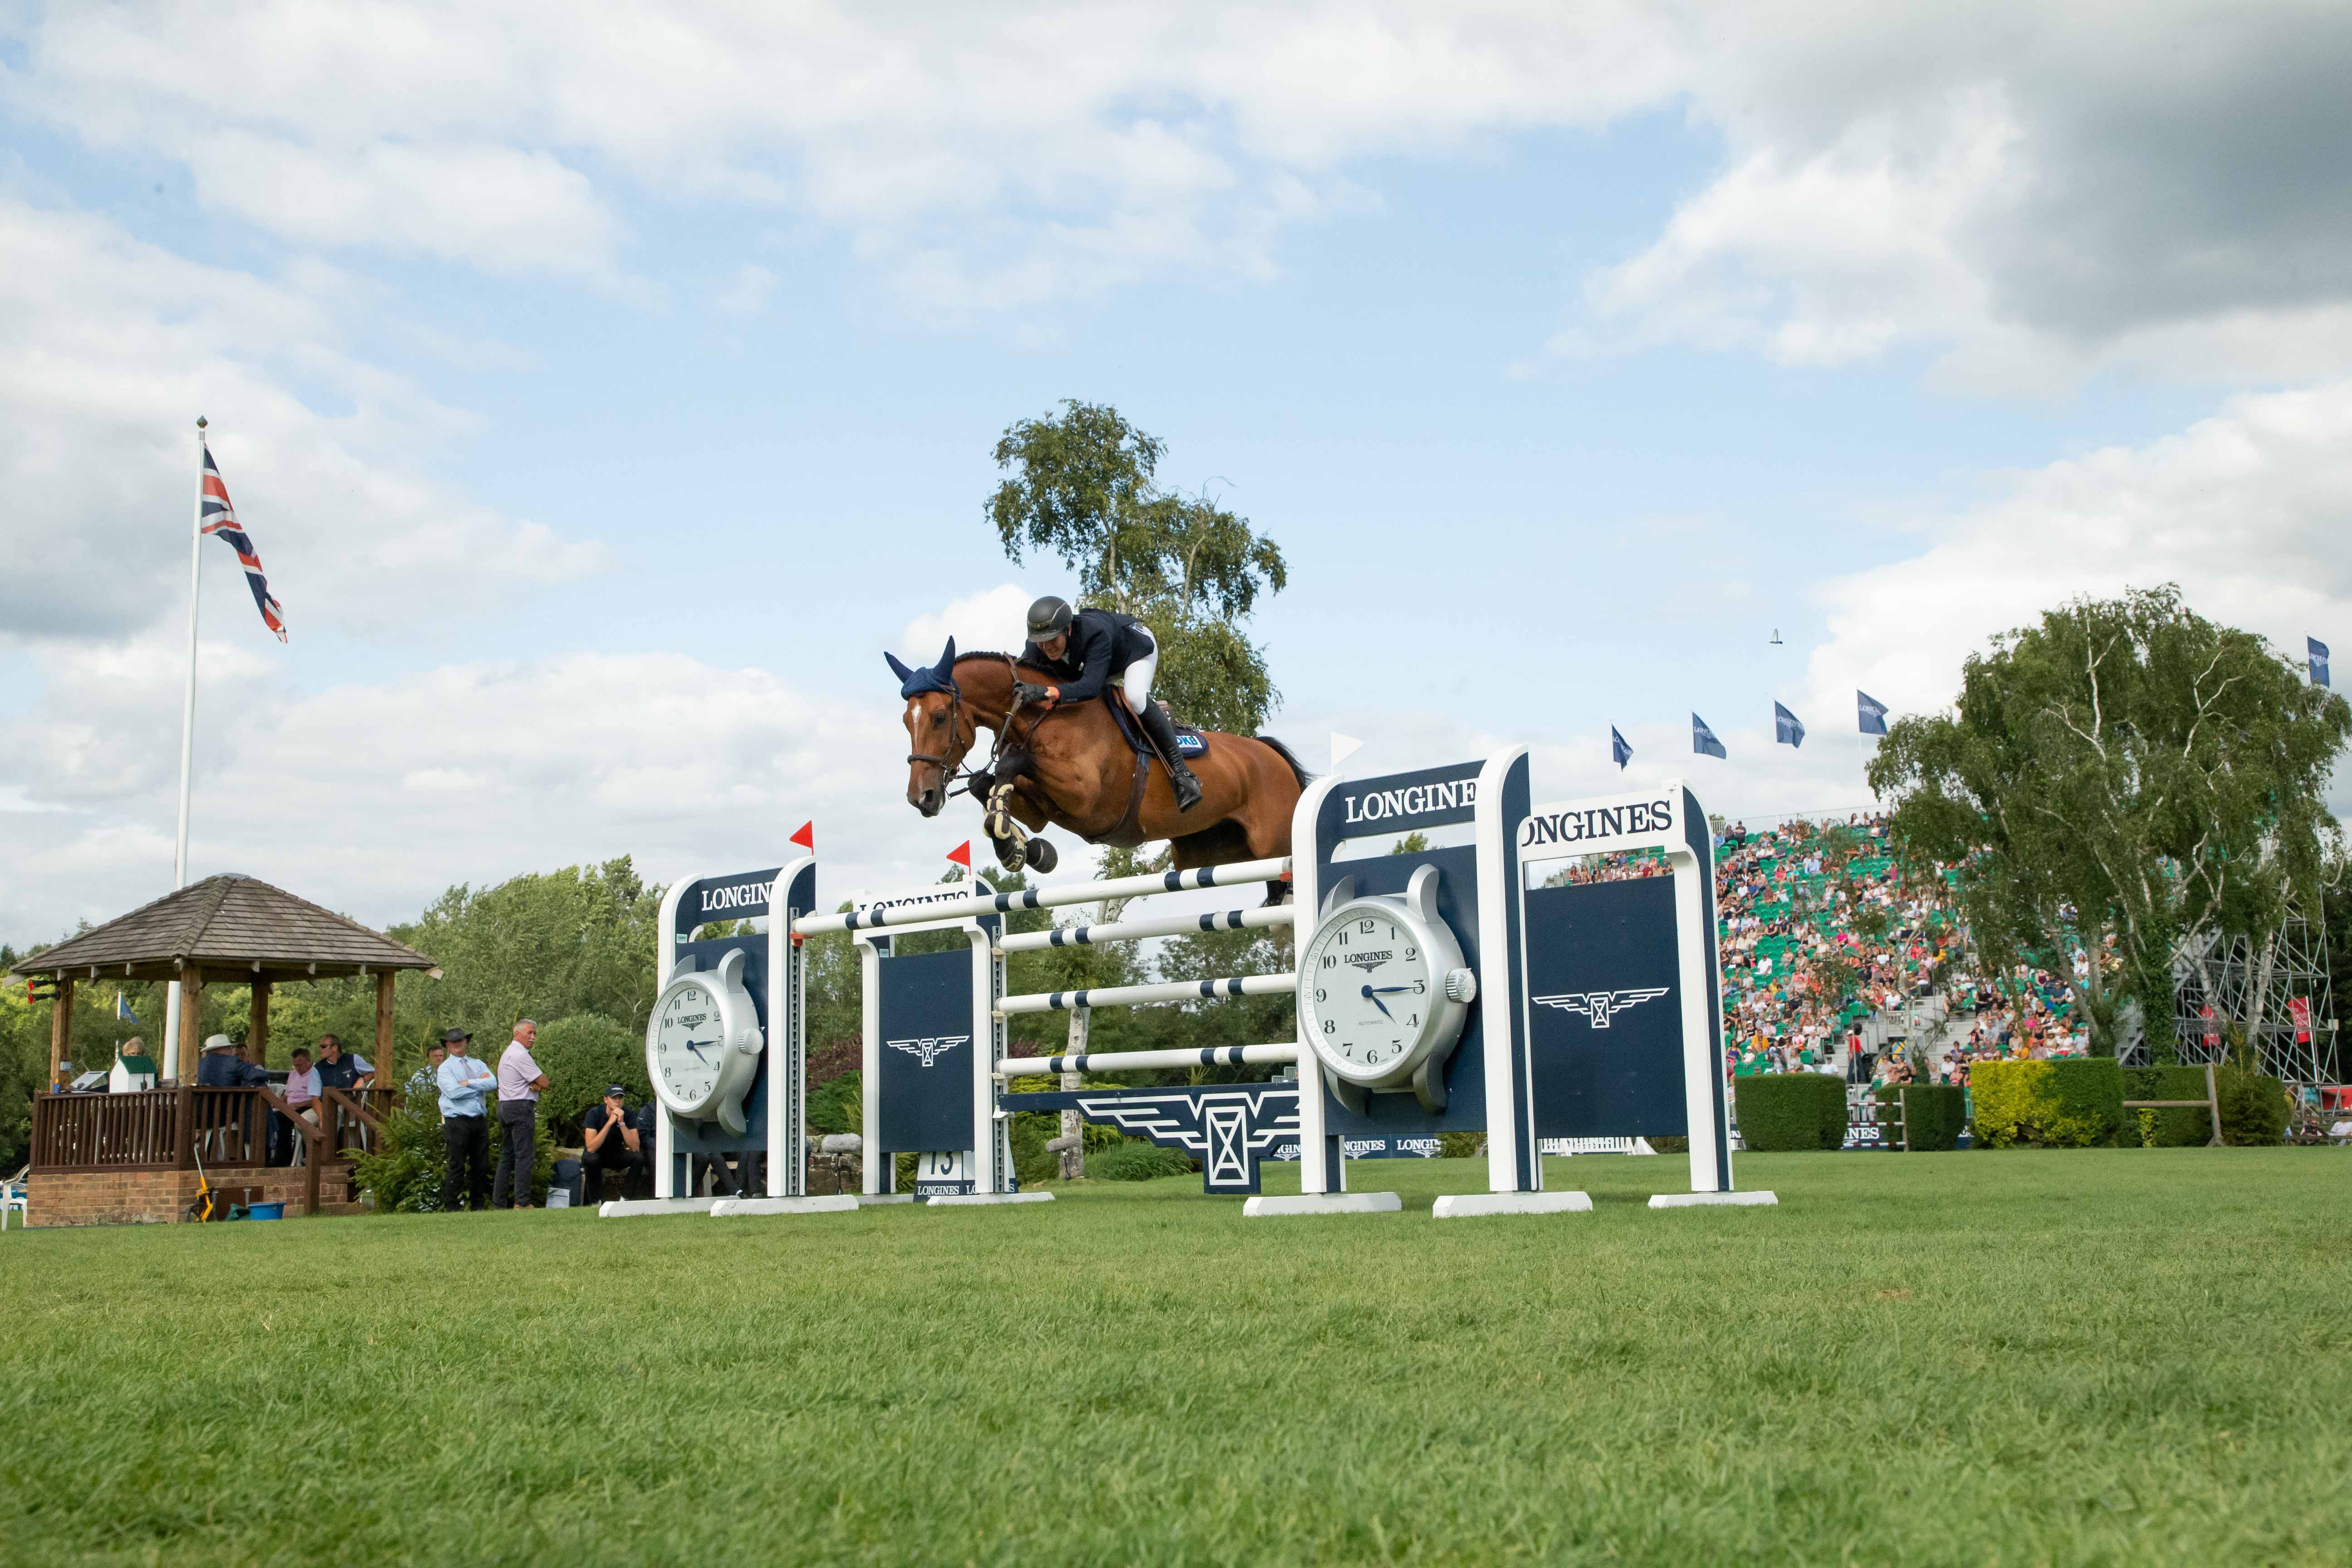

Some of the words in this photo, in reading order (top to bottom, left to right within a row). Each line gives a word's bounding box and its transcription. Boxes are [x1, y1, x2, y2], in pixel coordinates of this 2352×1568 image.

[1176, 736, 1198, 745] DKB
[1345, 777, 1477, 823] LONGINE
[701, 881, 774, 911] LONGIN
[1359, 920, 1374, 934] 12
[1390, 926, 1395, 940] 1
[1338, 931, 1348, 945] 11
[1344, 950, 1393, 963] LONGINES
[1405, 947, 1416, 961] 2
[1323, 955, 1337, 969] 10
[1413, 980, 1425, 995] 3
[687, 990, 696, 1001] 12
[1316, 988, 1327, 1002] 9
[674, 999, 681, 1010] 11
[664, 1017, 673, 1029] 10
[677, 1013, 707, 1024] LONGINES
[714, 1011, 720, 1022] 2
[1406, 1014, 1419, 1028] 4
[1324, 1019, 1335, 1034] 8
[660, 1043, 666, 1054] 9
[1343, 1043, 1353, 1057] 7
[1392, 1039, 1402, 1054] 5
[1367, 1049, 1378, 1064] 6
[664, 1067, 671, 1078] 8
[713, 1061, 720, 1072] 4
[675, 1084, 682, 1095] 7
[704, 1081, 711, 1092] 5
[689, 1089, 696, 1100] 6
[1344, 1140, 1386, 1151] NGINES
[917, 1185, 960, 1196] LONGINES
